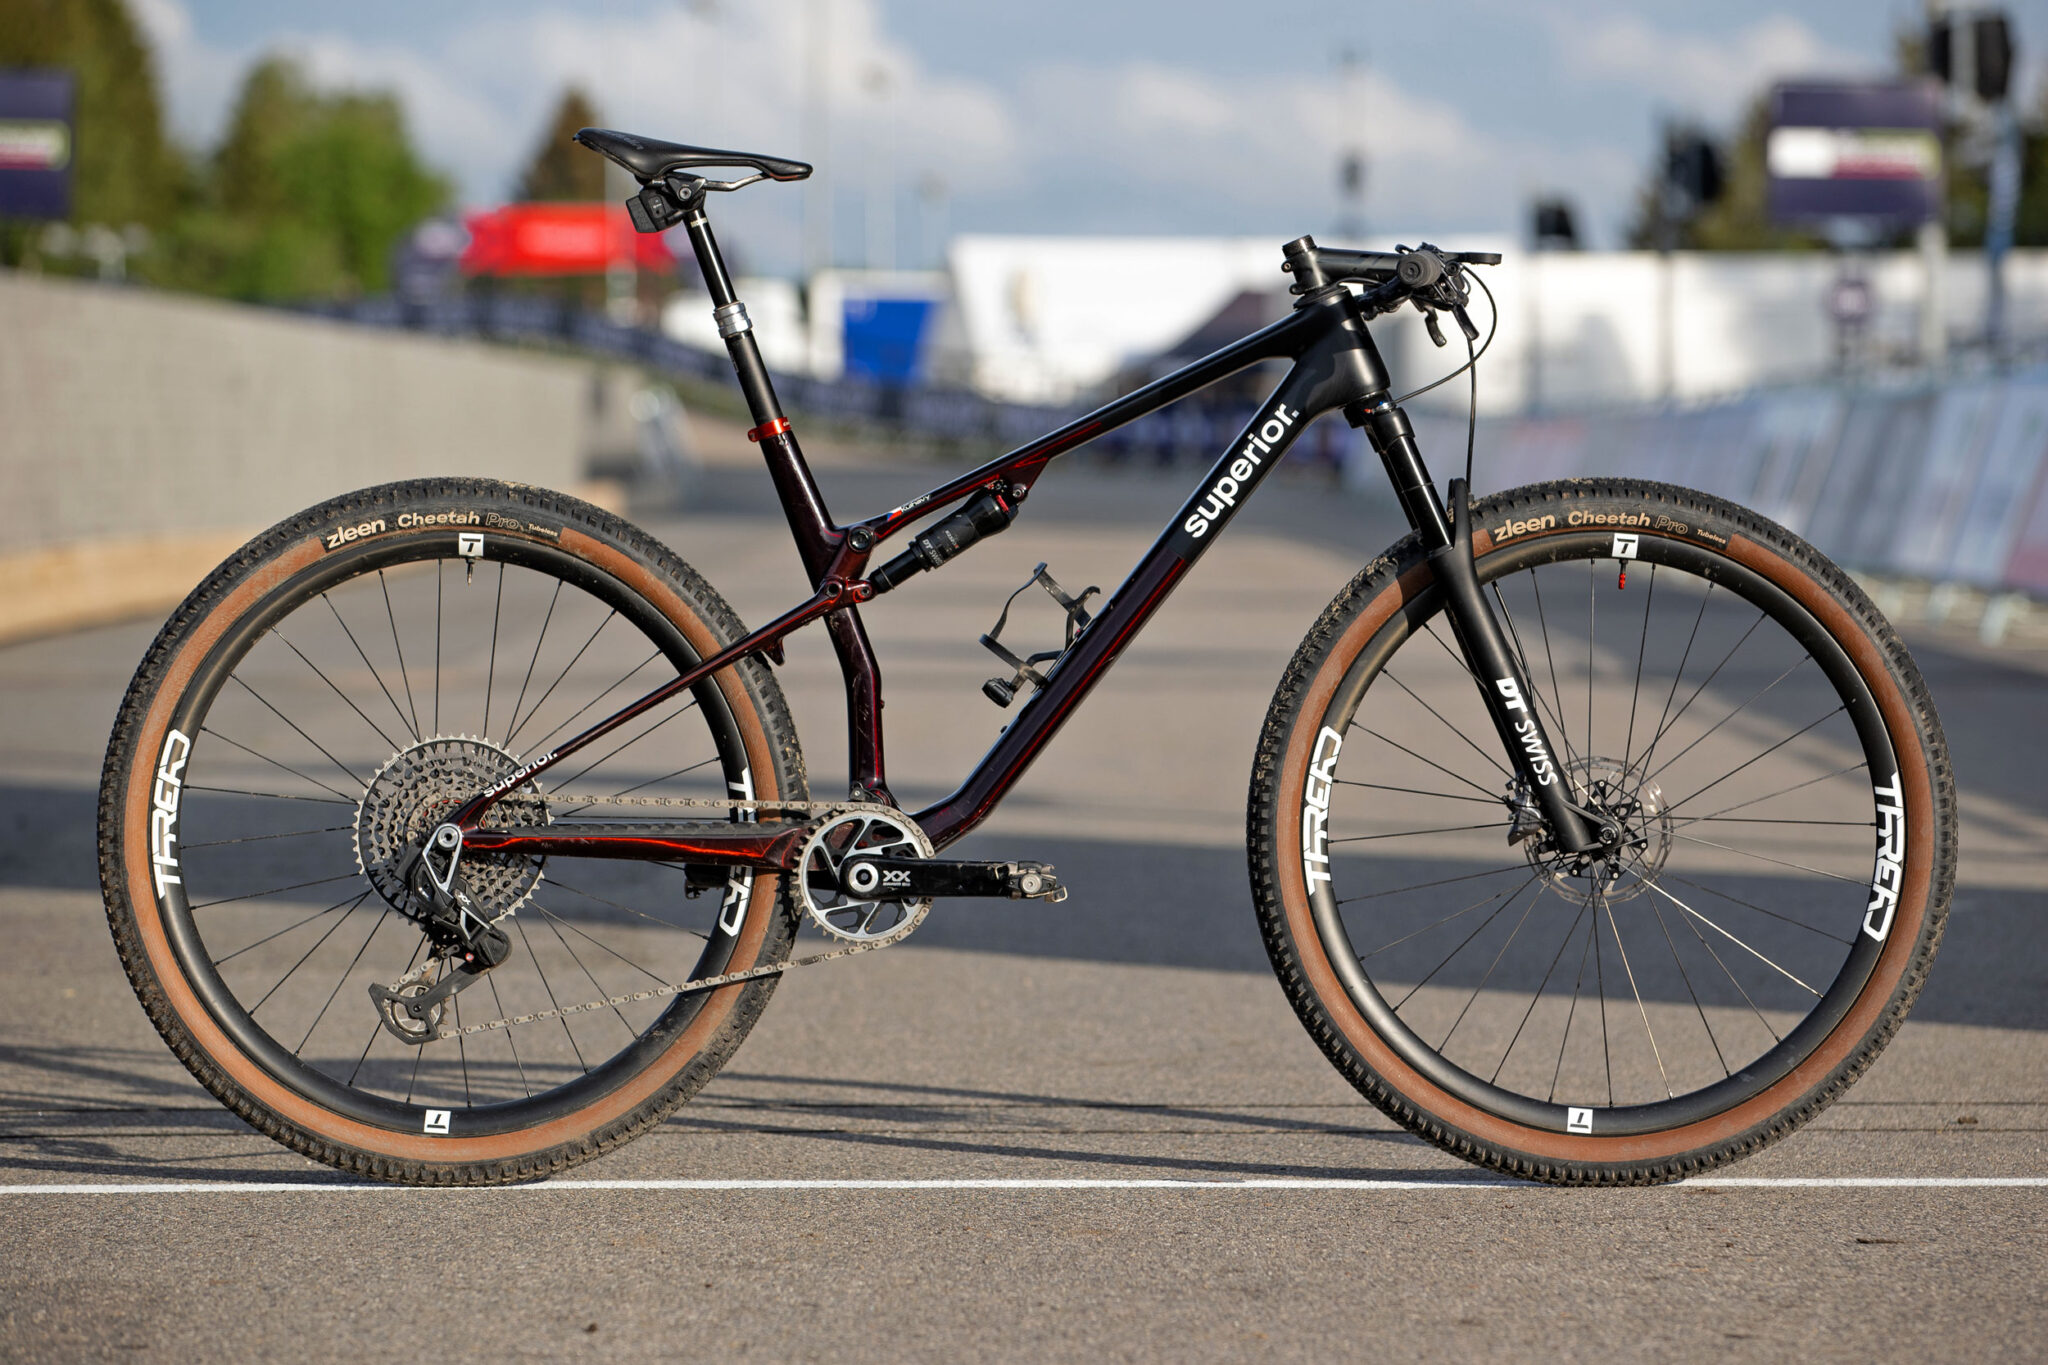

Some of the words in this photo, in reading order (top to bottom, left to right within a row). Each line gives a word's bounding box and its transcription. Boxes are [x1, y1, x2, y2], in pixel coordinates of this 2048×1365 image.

[1184, 403, 1300, 538] superior.
[326, 518, 386, 549] zleen
[398, 511, 480, 528] Cheetah
[485, 512, 519, 530] Pro
[528, 522, 558, 537] Tubeless
[1494, 513, 1556, 542] zleen
[1568, 511, 1651, 527] Cheetah
[1655, 515, 1689, 534] Pro
[1697, 528, 1727, 545] Tubeless
[1496, 677, 1528, 713] DT
[1514, 719, 1559, 786] SWISS
[882, 870, 911, 882] XX
